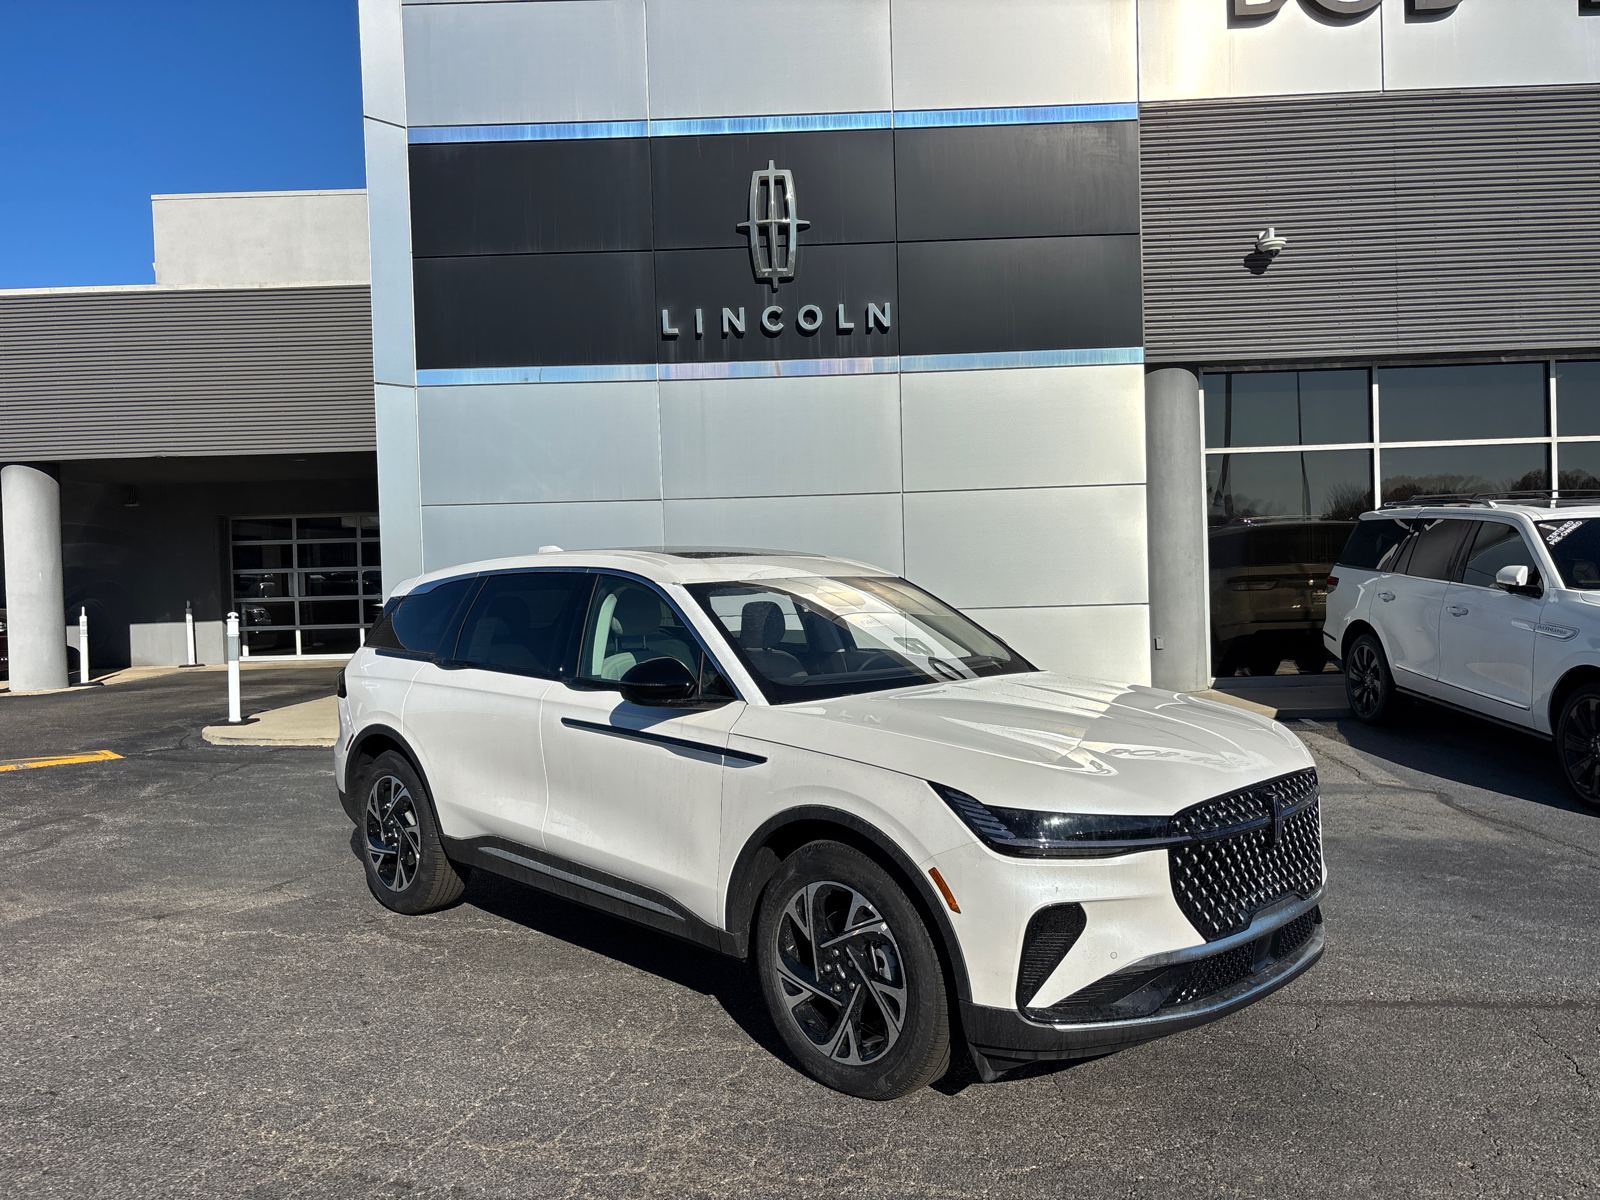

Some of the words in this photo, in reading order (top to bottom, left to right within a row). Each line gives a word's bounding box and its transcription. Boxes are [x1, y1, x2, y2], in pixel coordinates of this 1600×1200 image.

[662, 302, 891, 336] LINCOLN
[1546, 520, 1574, 541] CERTIFIED
[1549, 521, 1583, 546] PRE-OWNED
